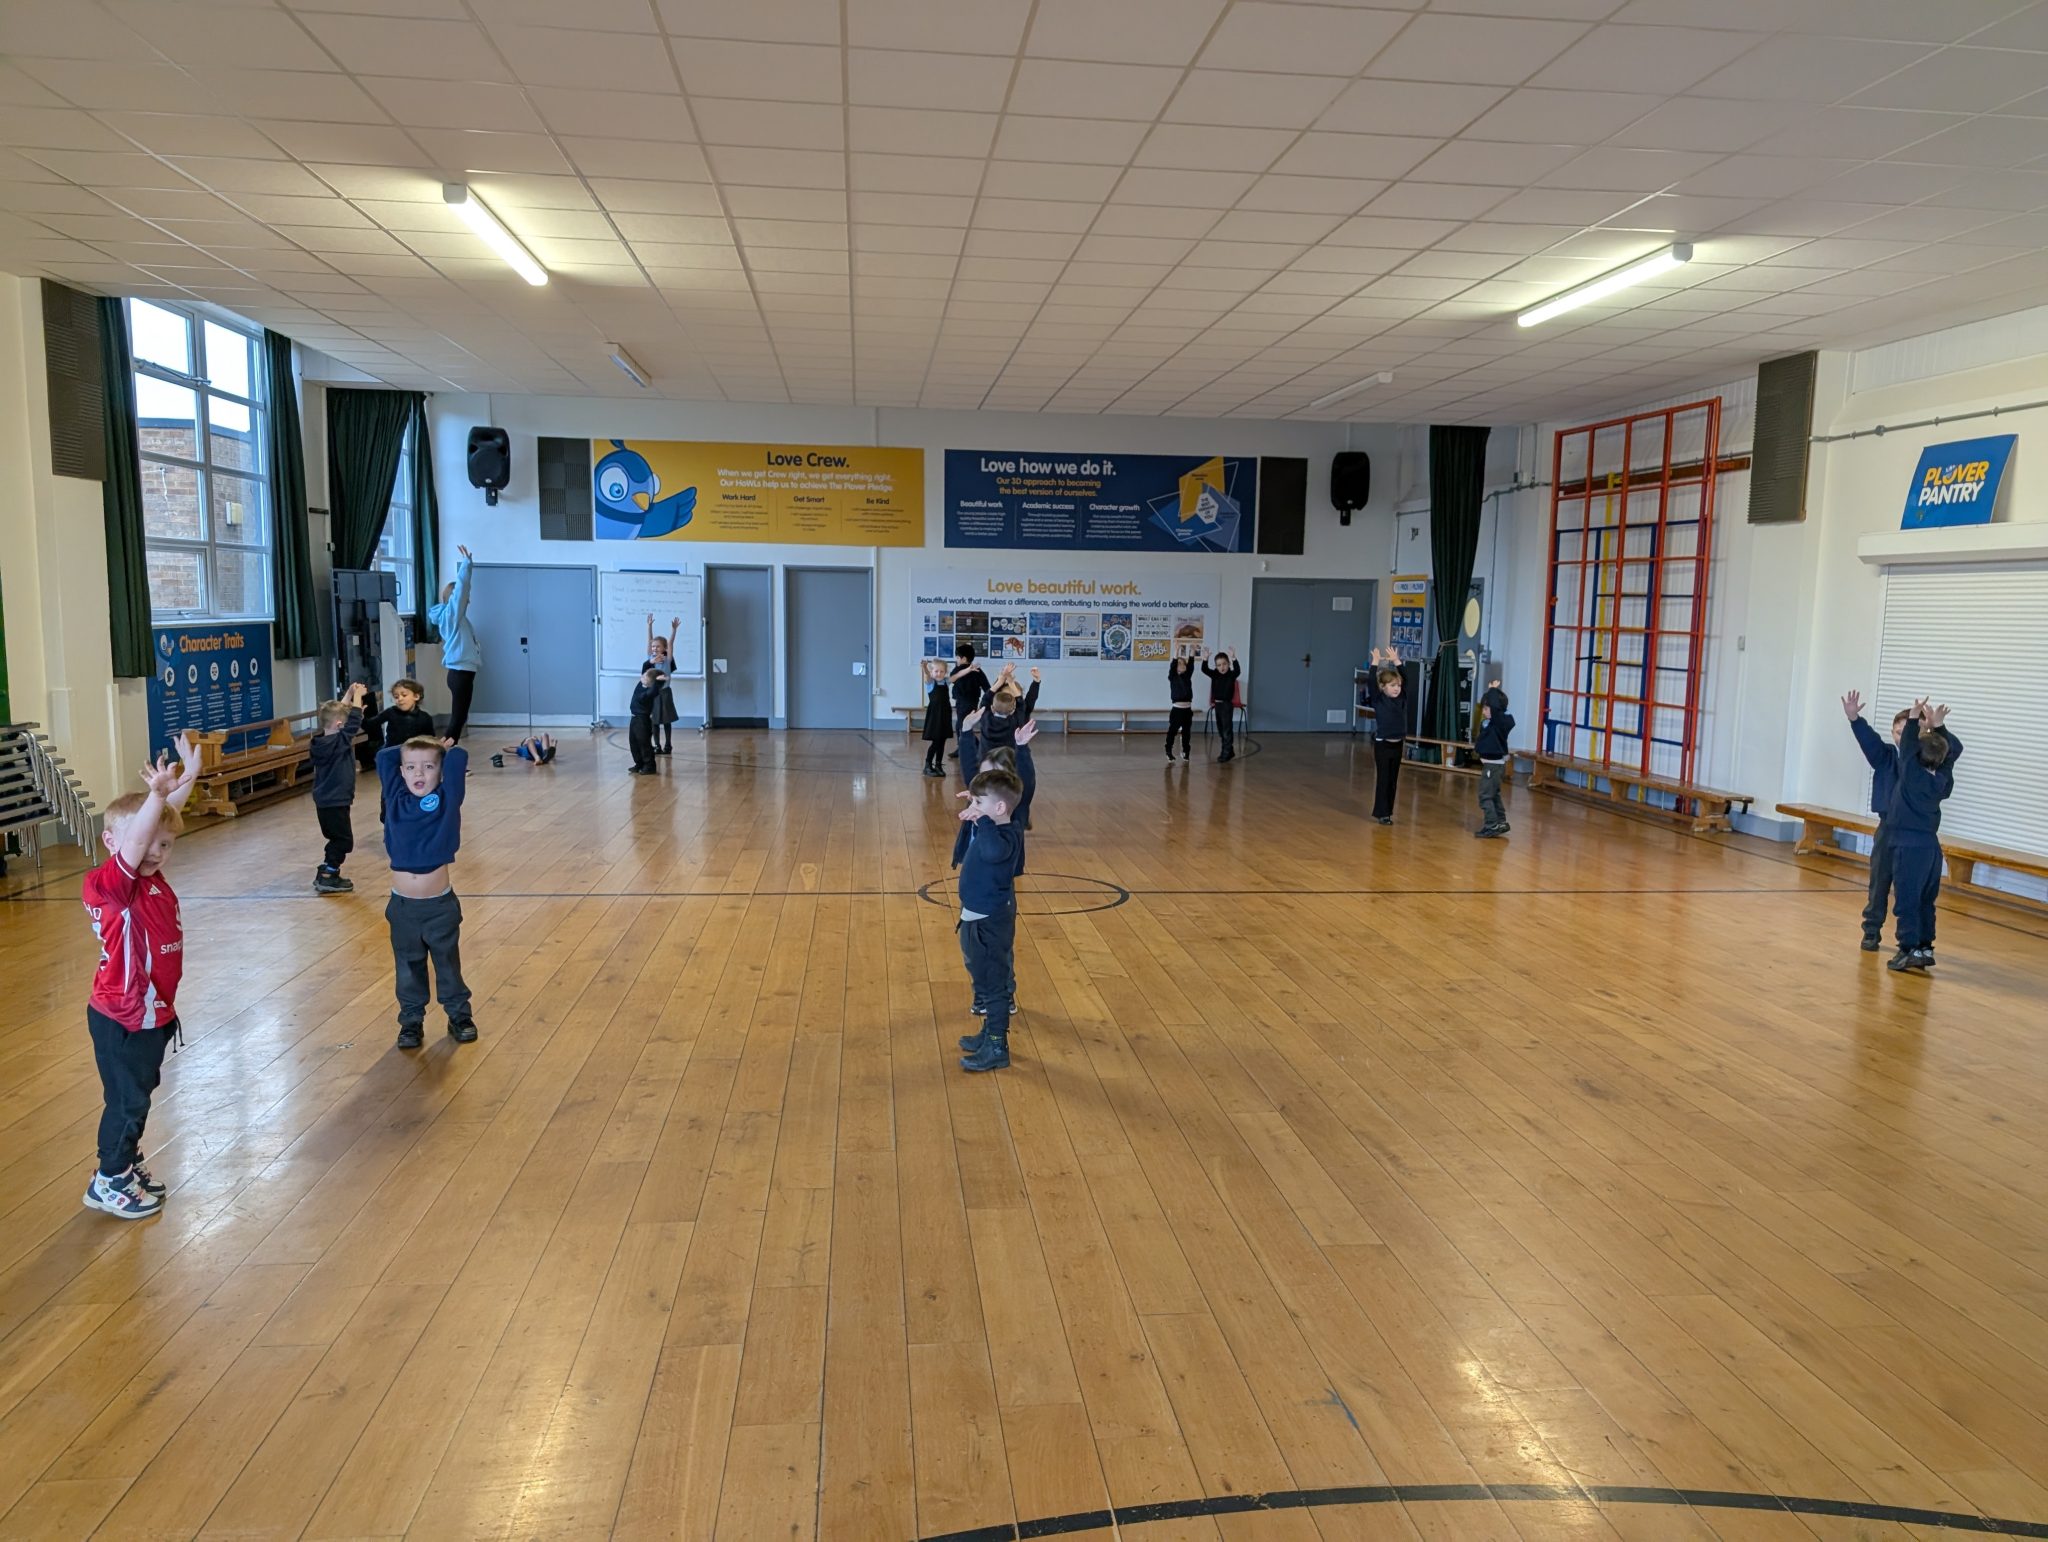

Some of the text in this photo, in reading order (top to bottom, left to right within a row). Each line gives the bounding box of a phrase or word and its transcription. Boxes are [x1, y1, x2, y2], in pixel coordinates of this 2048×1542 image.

[767, 451, 850, 468] Love Crew.
[981, 457, 1116, 476] Love how we do it.
[717, 468, 740, 476] When
[754, 470, 766, 479] get
[822, 472, 834, 481] get
[835, 473, 872, 482] everything
[1924, 461, 1990, 486] PLOVER
[762, 480, 779, 489] help
[800, 482, 828, 490] achieve
[844, 482, 866, 490] Plover
[1023, 478, 1056, 487] approach
[1066, 479, 1102, 488] becoming
[1012, 487, 1027, 495] best
[1055, 488, 1063, 496] of
[1064, 488, 1098, 497] ourselves.
[1918, 481, 1984, 506] PANTRY
[1119, 504, 1140, 512] growth
[988, 579, 1142, 596] Love beautiful work.
[1014, 598, 1050, 606] difference,
[1052, 598, 1092, 608] contributing
[1102, 600, 1128, 608] making
[1168, 600, 1188, 608] better
[1190, 601, 1210, 610] place.
[180, 632, 244, 653] Character Traits
